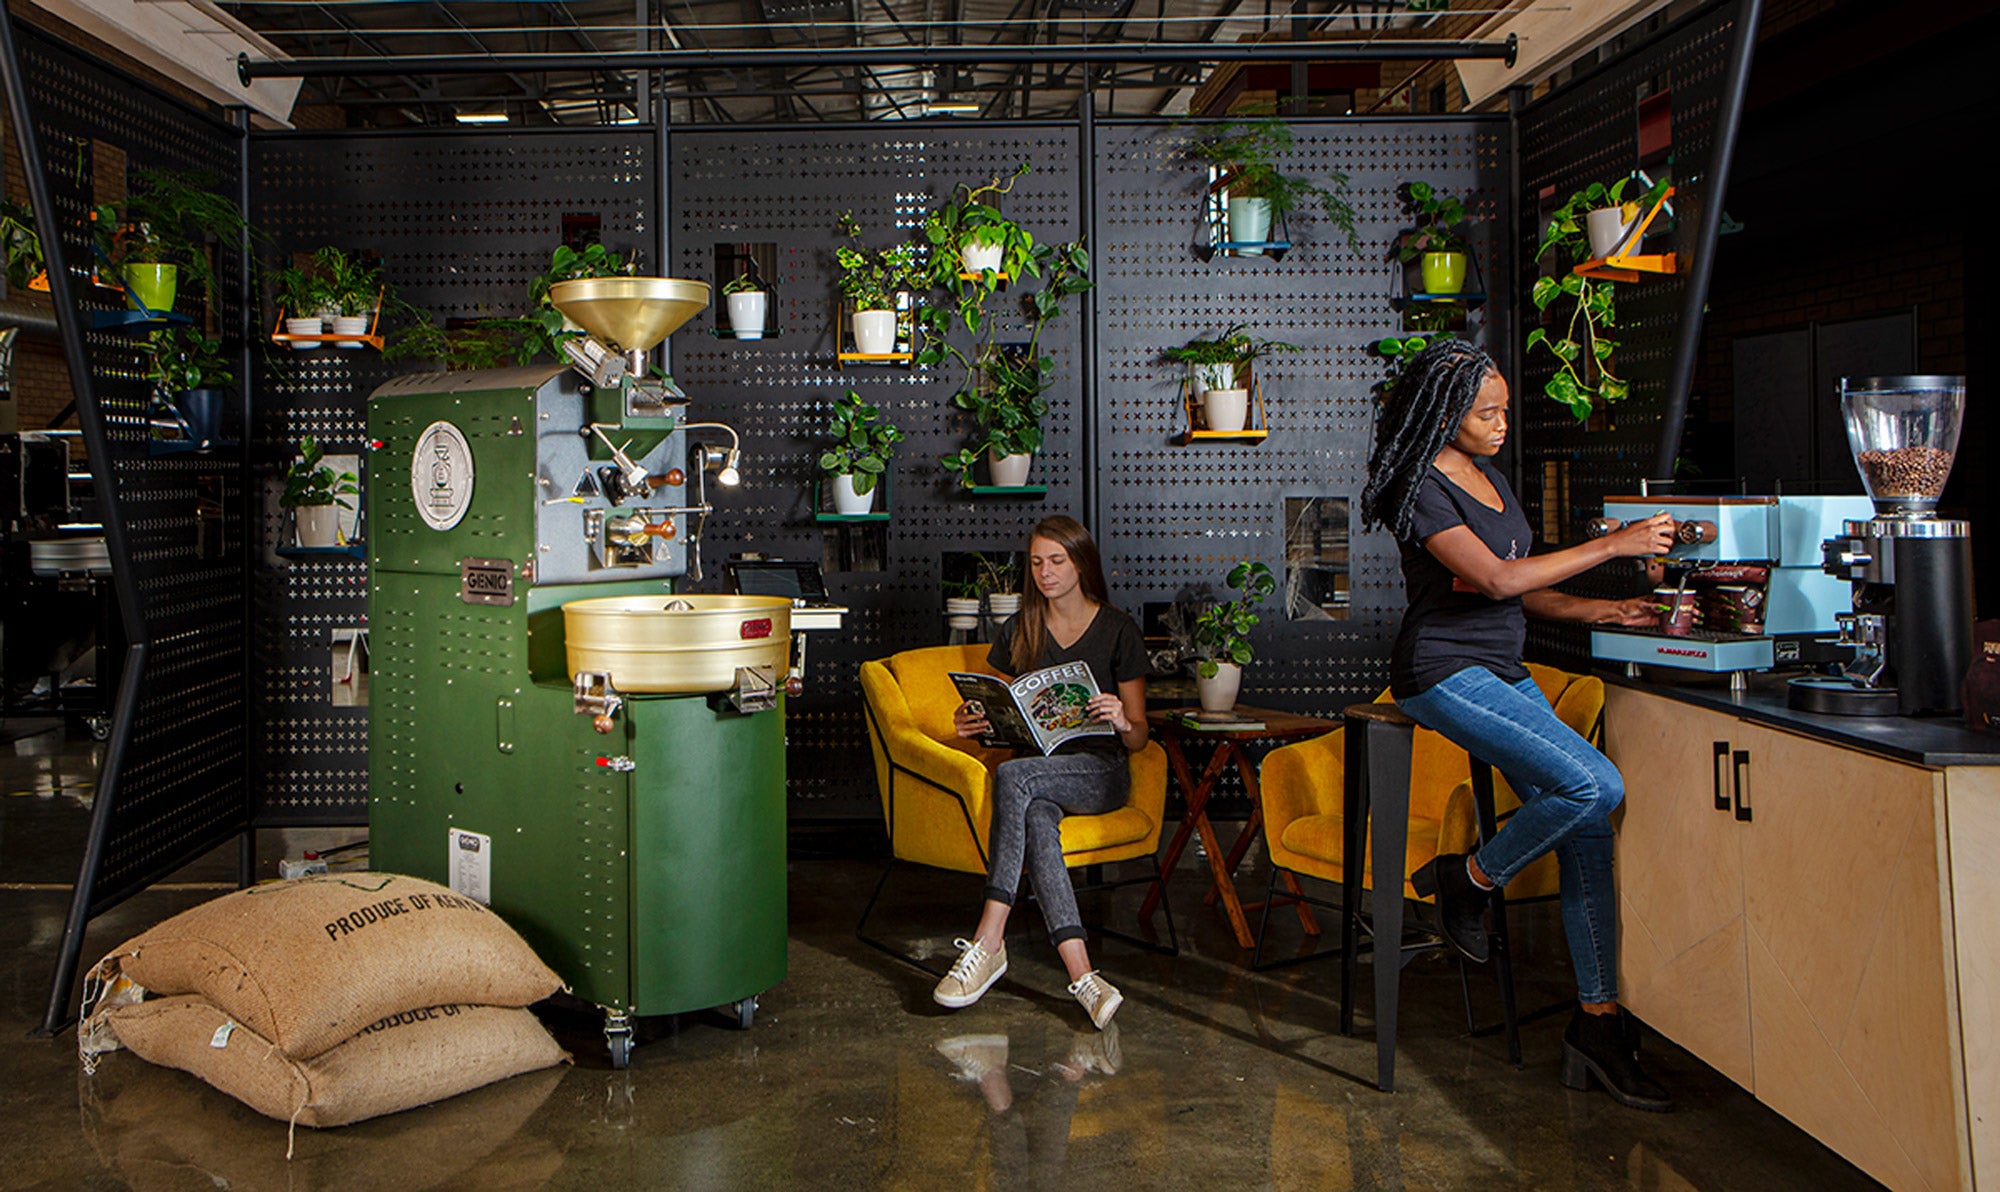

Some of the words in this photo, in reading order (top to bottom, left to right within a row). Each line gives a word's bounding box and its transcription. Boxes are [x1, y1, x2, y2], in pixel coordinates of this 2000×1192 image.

[467, 572, 507, 590] GENIO
[1014, 664, 1085, 697] COFFEE
[324, 898, 409, 941] PRODUCE
[409, 894, 432, 910] OF
[432, 894, 485, 913] KENYA
[342, 1006, 440, 1045] ODUCE
